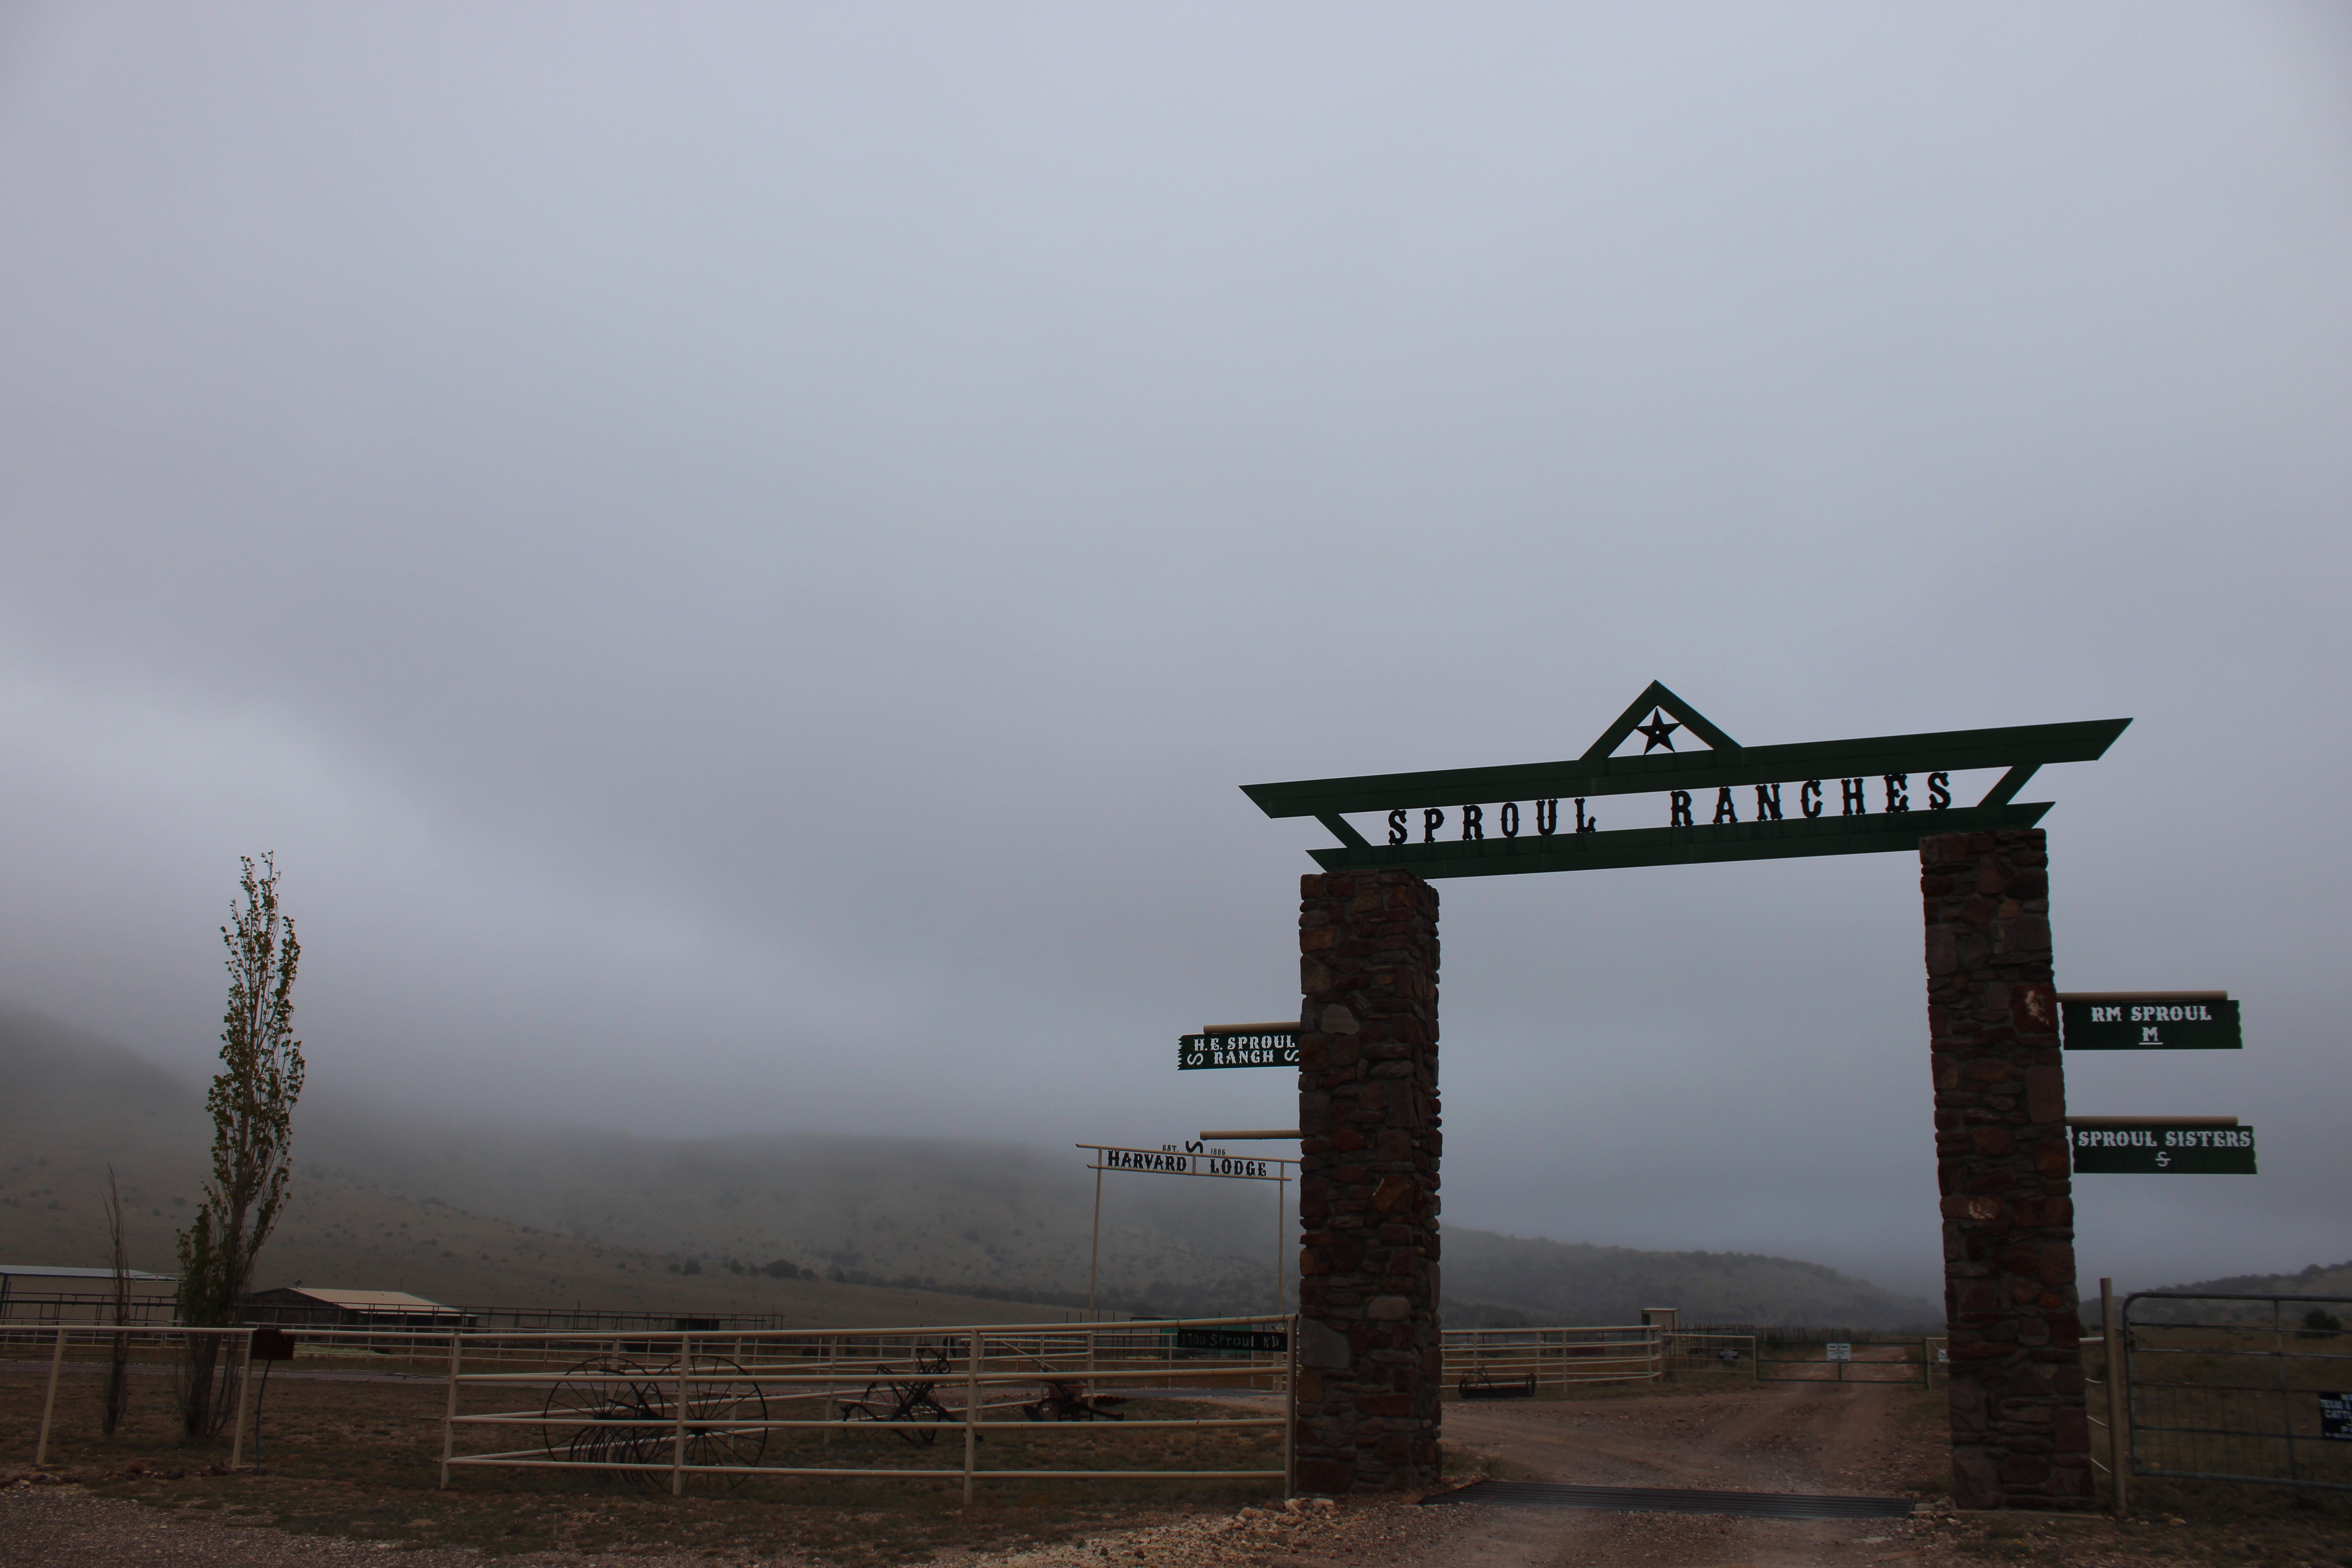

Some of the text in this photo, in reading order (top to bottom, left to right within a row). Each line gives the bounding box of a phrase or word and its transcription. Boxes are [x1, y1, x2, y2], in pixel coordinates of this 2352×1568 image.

[1388, 772, 1951, 845] SPROUL RANCHES
[2091, 1006, 2212, 1022] RM SPROUL
[1227, 1035, 1295, 1050] SPROUL
[2142, 1027, 2159, 1042] M
[1214, 1049, 1274, 1065] RANCH
[2078, 1131, 2251, 1147] SPROUL SISTERS
[1108, 1150, 1267, 1177] HARVARD LODGE
